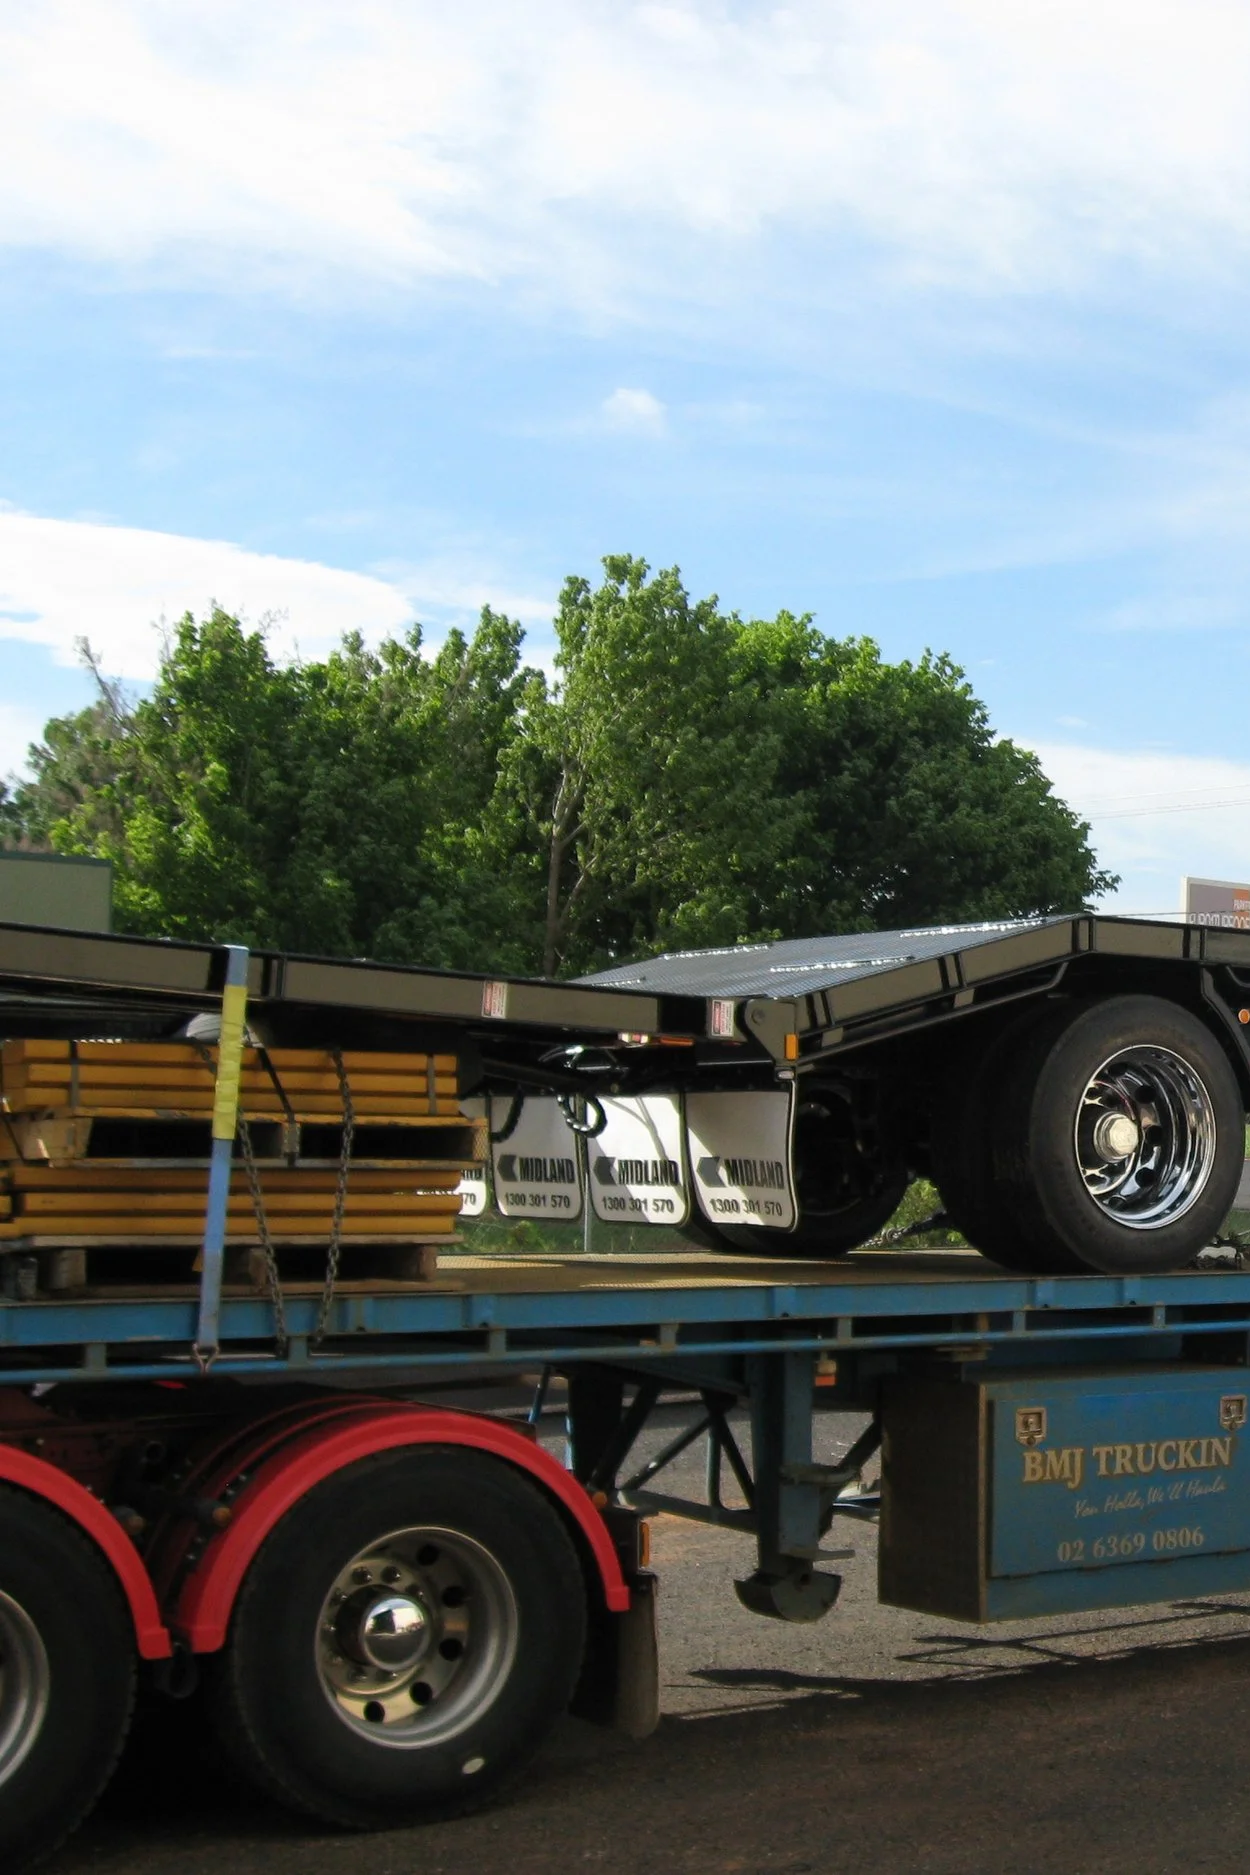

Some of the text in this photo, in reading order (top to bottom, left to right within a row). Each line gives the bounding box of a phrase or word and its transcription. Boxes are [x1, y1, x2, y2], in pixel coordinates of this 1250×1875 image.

[519, 1157, 575, 1184] MIDLAND
[617, 1158, 679, 1187] MIDLAND
[724, 1158, 786, 1190] MIDLAND
[504, 1192, 571, 1209] 1300 301 570
[602, 1196, 675, 1214] 1300 301 570
[710, 1198, 783, 1217] 1300 301 570
[1023, 1436, 1234, 1490] BMJ TRUCKIN
[1057, 1526, 1205, 1562] 02 6369 0806
